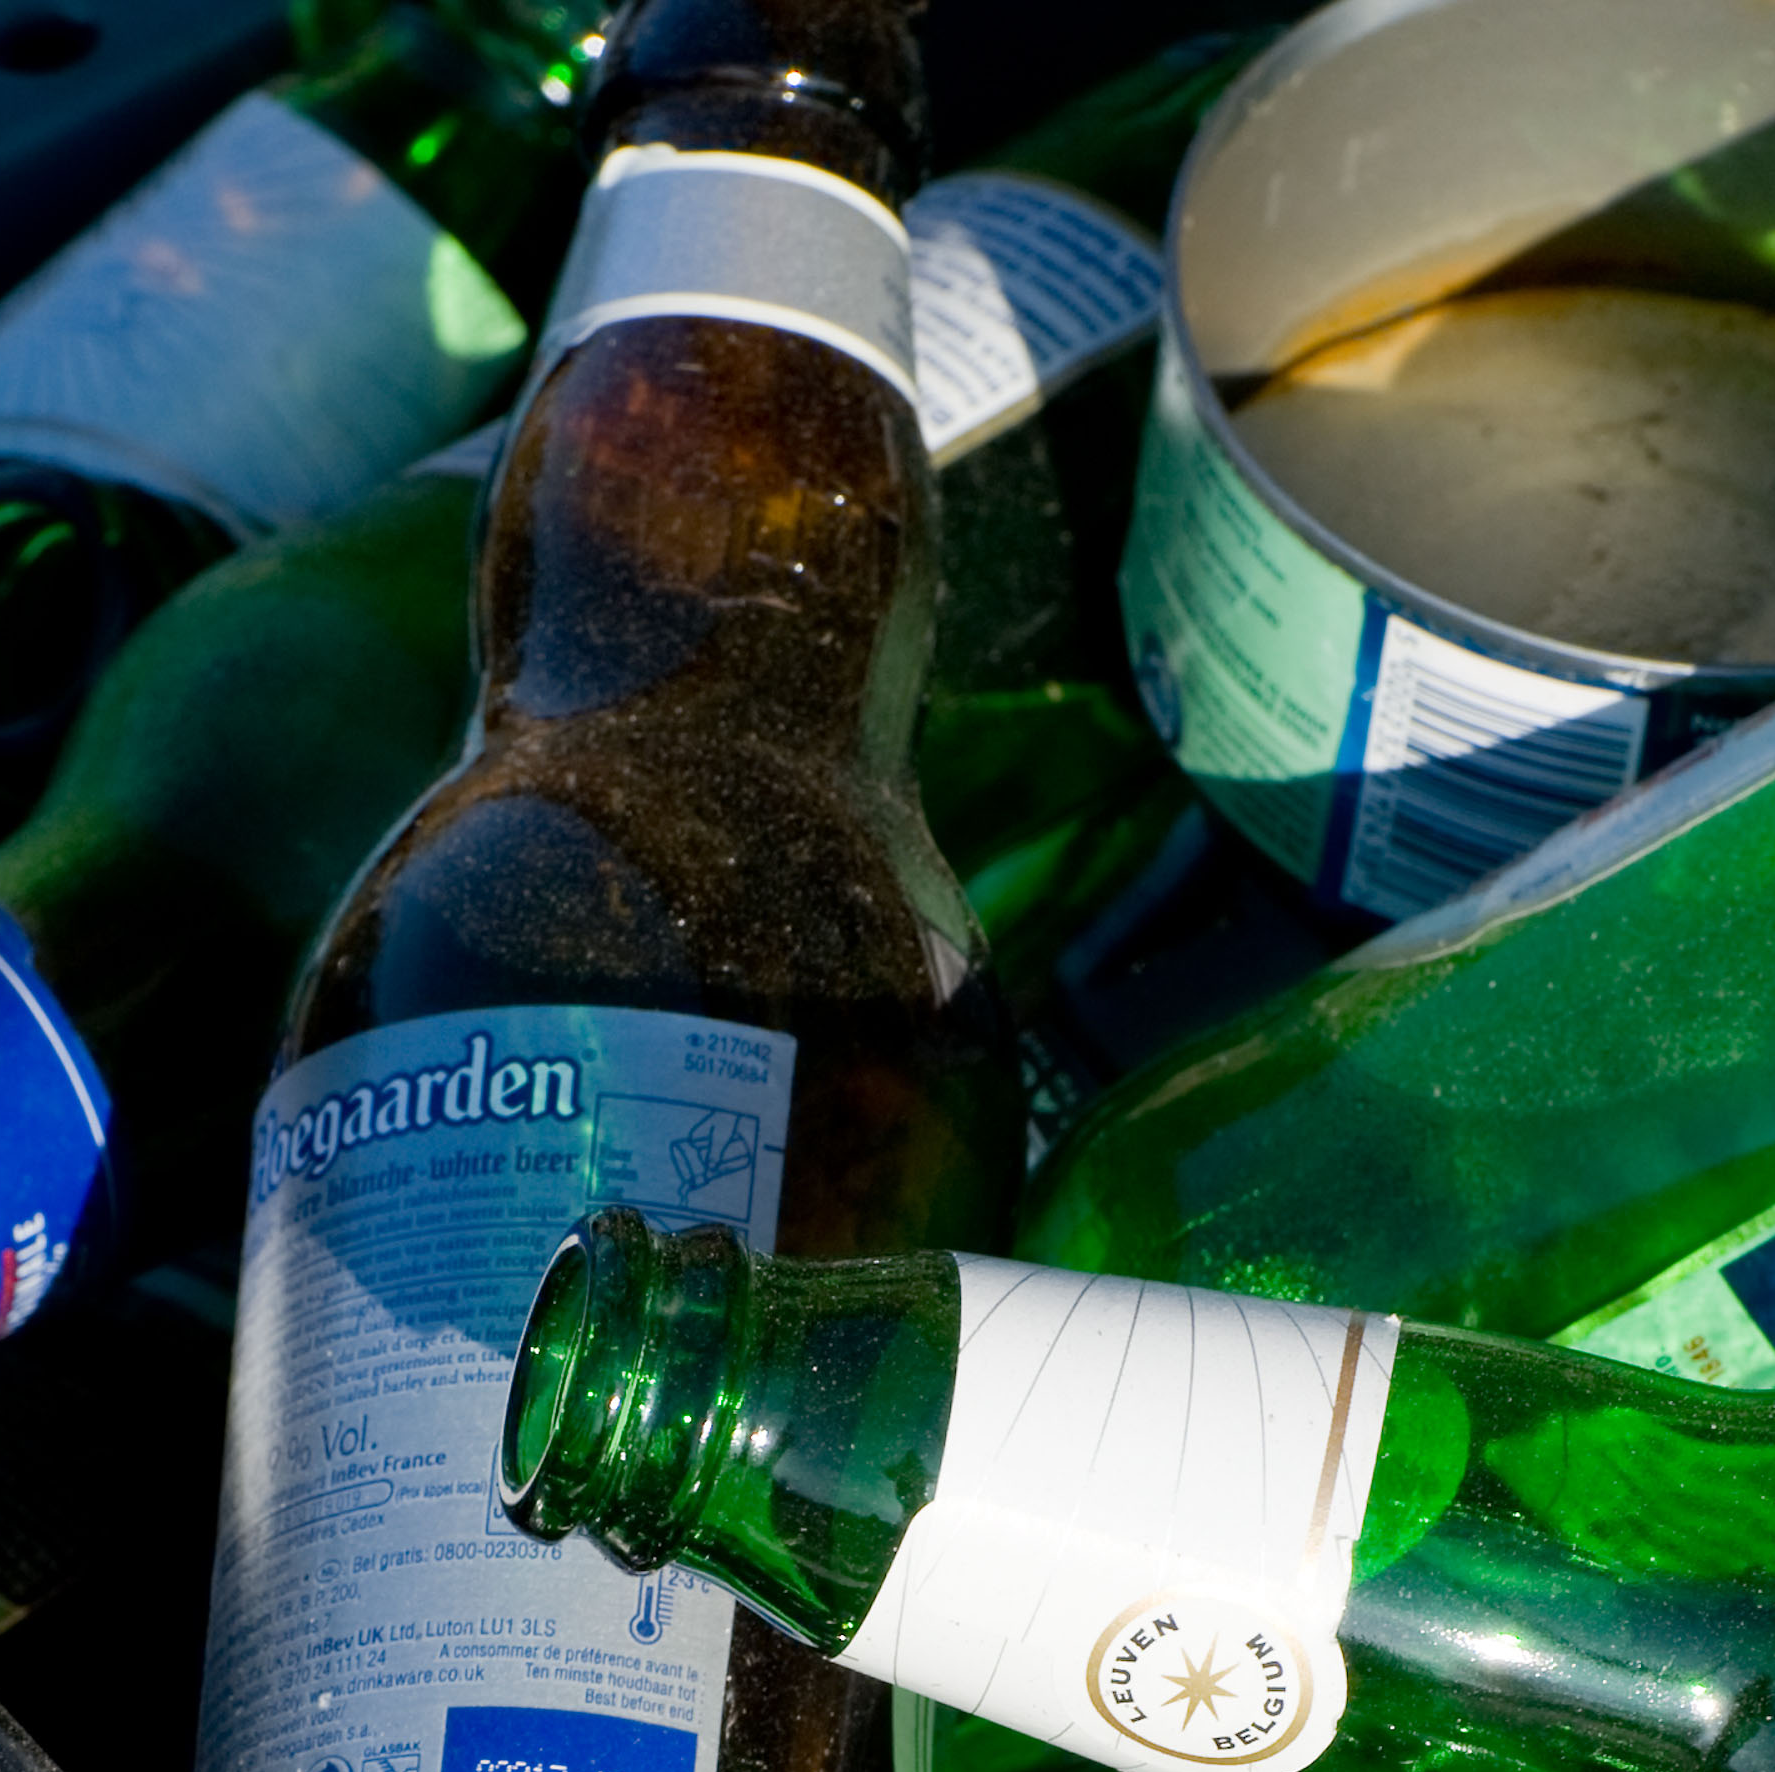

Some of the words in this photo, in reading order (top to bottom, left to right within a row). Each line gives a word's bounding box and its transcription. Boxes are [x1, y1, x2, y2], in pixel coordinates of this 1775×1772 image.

[708, 1033, 773, 1064] 217042
[253, 1029, 584, 1202] Hoegaarden
[430, 1146, 509, 1180] white
[514, 1146, 580, 1178] beer
[321, 1414, 379, 1459] Vol.
[329, 1453, 380, 1485] InBev
[382, 1448, 448, 1471] France
[351, 1553, 374, 1575] Bel
[434, 1541, 564, 1564] 0800-0230376
[304, 1634, 354, 1663] InBev
[357, 1624, 385, 1647] UK
[424, 1617, 475, 1640] Luton
[479, 1618, 514, 1638] LU1
[520, 1617, 558, 1639] 3LS
[451, 1643, 541, 1661] consommer
[542, 1644, 562, 1662] de
[563, 1644, 642, 1674] préférence
[645, 1656, 683, 1679] avant
[524, 1661, 548, 1680] Ten
[551, 1664, 606, 1686] minste
[606, 1669, 676, 1699] houdbaar
[1110, 1613, 1180, 1724] LEUVEN
[1212, 1633, 1287, 1751] BELGIUM
[583, 1687, 618, 1707] Best
[619, 1691, 667, 1717] before
[668, 1700, 697, 1723] end
[362, 1740, 424, 1758] GLASBAK
